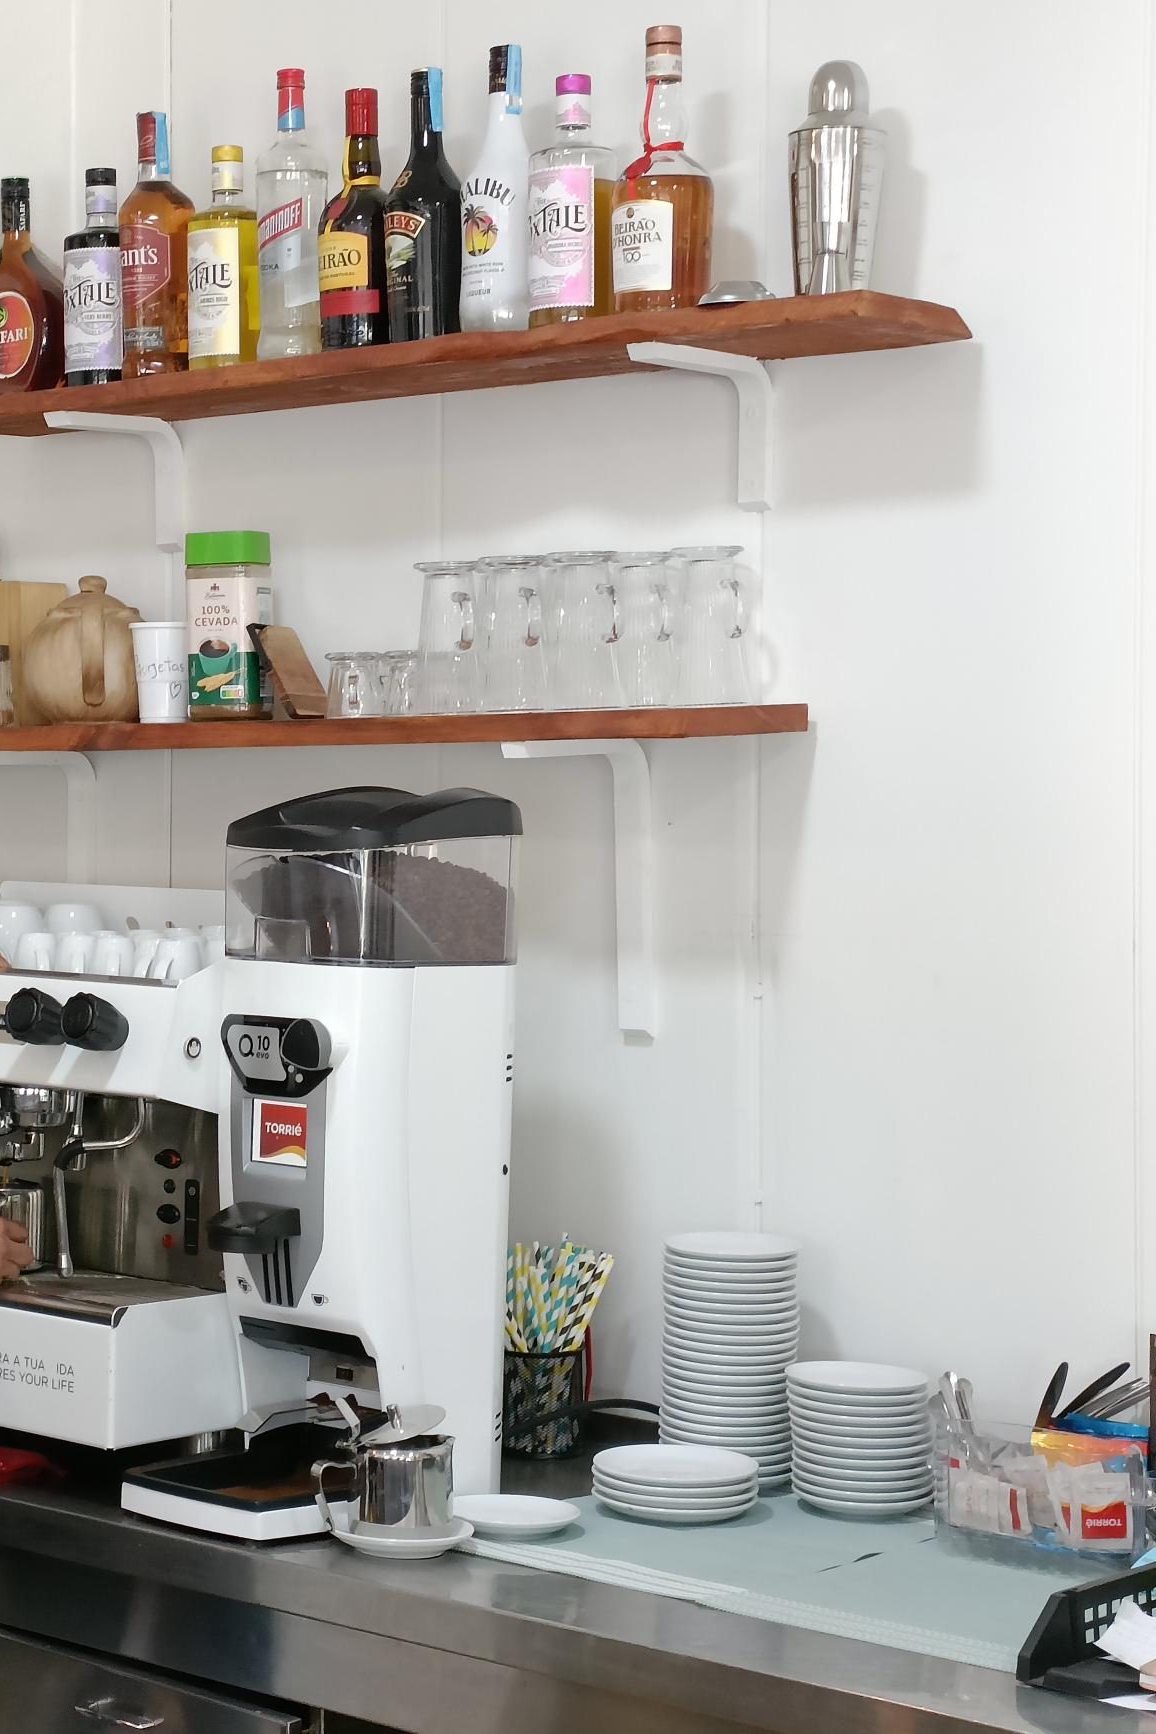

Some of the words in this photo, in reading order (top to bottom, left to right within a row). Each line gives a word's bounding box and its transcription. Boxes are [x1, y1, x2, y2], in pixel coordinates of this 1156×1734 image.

[528, 202, 587, 238] XTALE
[614, 218, 656, 236] BEIRÃO
[121, 244, 158, 266] ant's
[64, 280, 117, 310] XTALE
[202, 605, 230, 615] 100%
[195, 617, 239, 627] CEVADA
[257, 1035, 270, 1051] 10
[256, 1052, 270, 1060] evo
[13, 1355, 21, 1366] A
[24, 1357, 45, 1370] TUA
[19, 1371, 49, 1388] YOUR
[51, 1378, 75, 1394] LIFE
